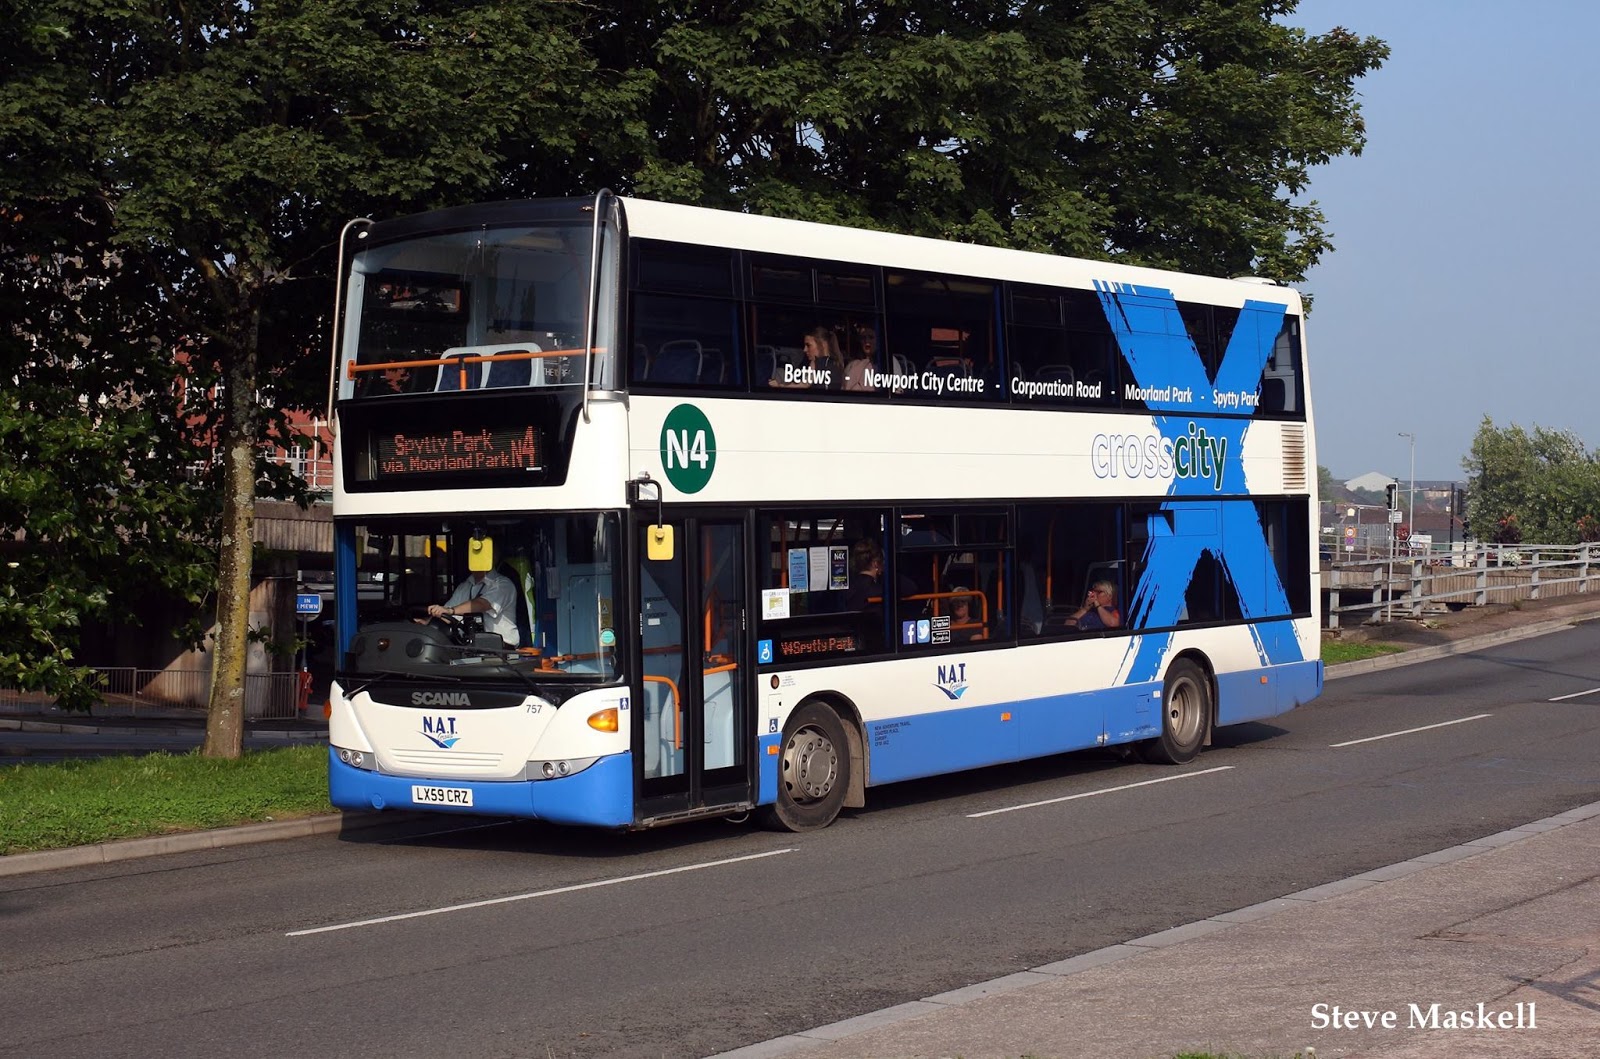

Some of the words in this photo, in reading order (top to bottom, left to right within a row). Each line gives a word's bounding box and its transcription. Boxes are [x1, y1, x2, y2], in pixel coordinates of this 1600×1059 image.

[784, 363, 831, 385] Bettws
[864, 368, 918, 393] Newport
[921, 372, 944, 395] City
[946, 373, 984, 393] Centre
[1011, 376, 1074, 398] Corporation
[1076, 381, 1101, 399] Road
[1125, 384, 1171, 402] Moorland
[1172, 387, 1193, 403] Park
[1213, 389, 1240, 409] Spytty
[1241, 391, 1260, 407] Park
[394, 434, 448, 456] Spytty
[452, 429, 494, 452] Park
[511, 426, 535, 468] N4
[667, 429, 709, 469] N4
[409, 455, 473, 471] Moorland
[475, 451, 510, 468] Park
[411, 691, 471, 706] SCANIA
[526, 704, 542, 714] 757
[416, 787, 445, 802] LX59
[447, 789, 469, 804] CRZ
